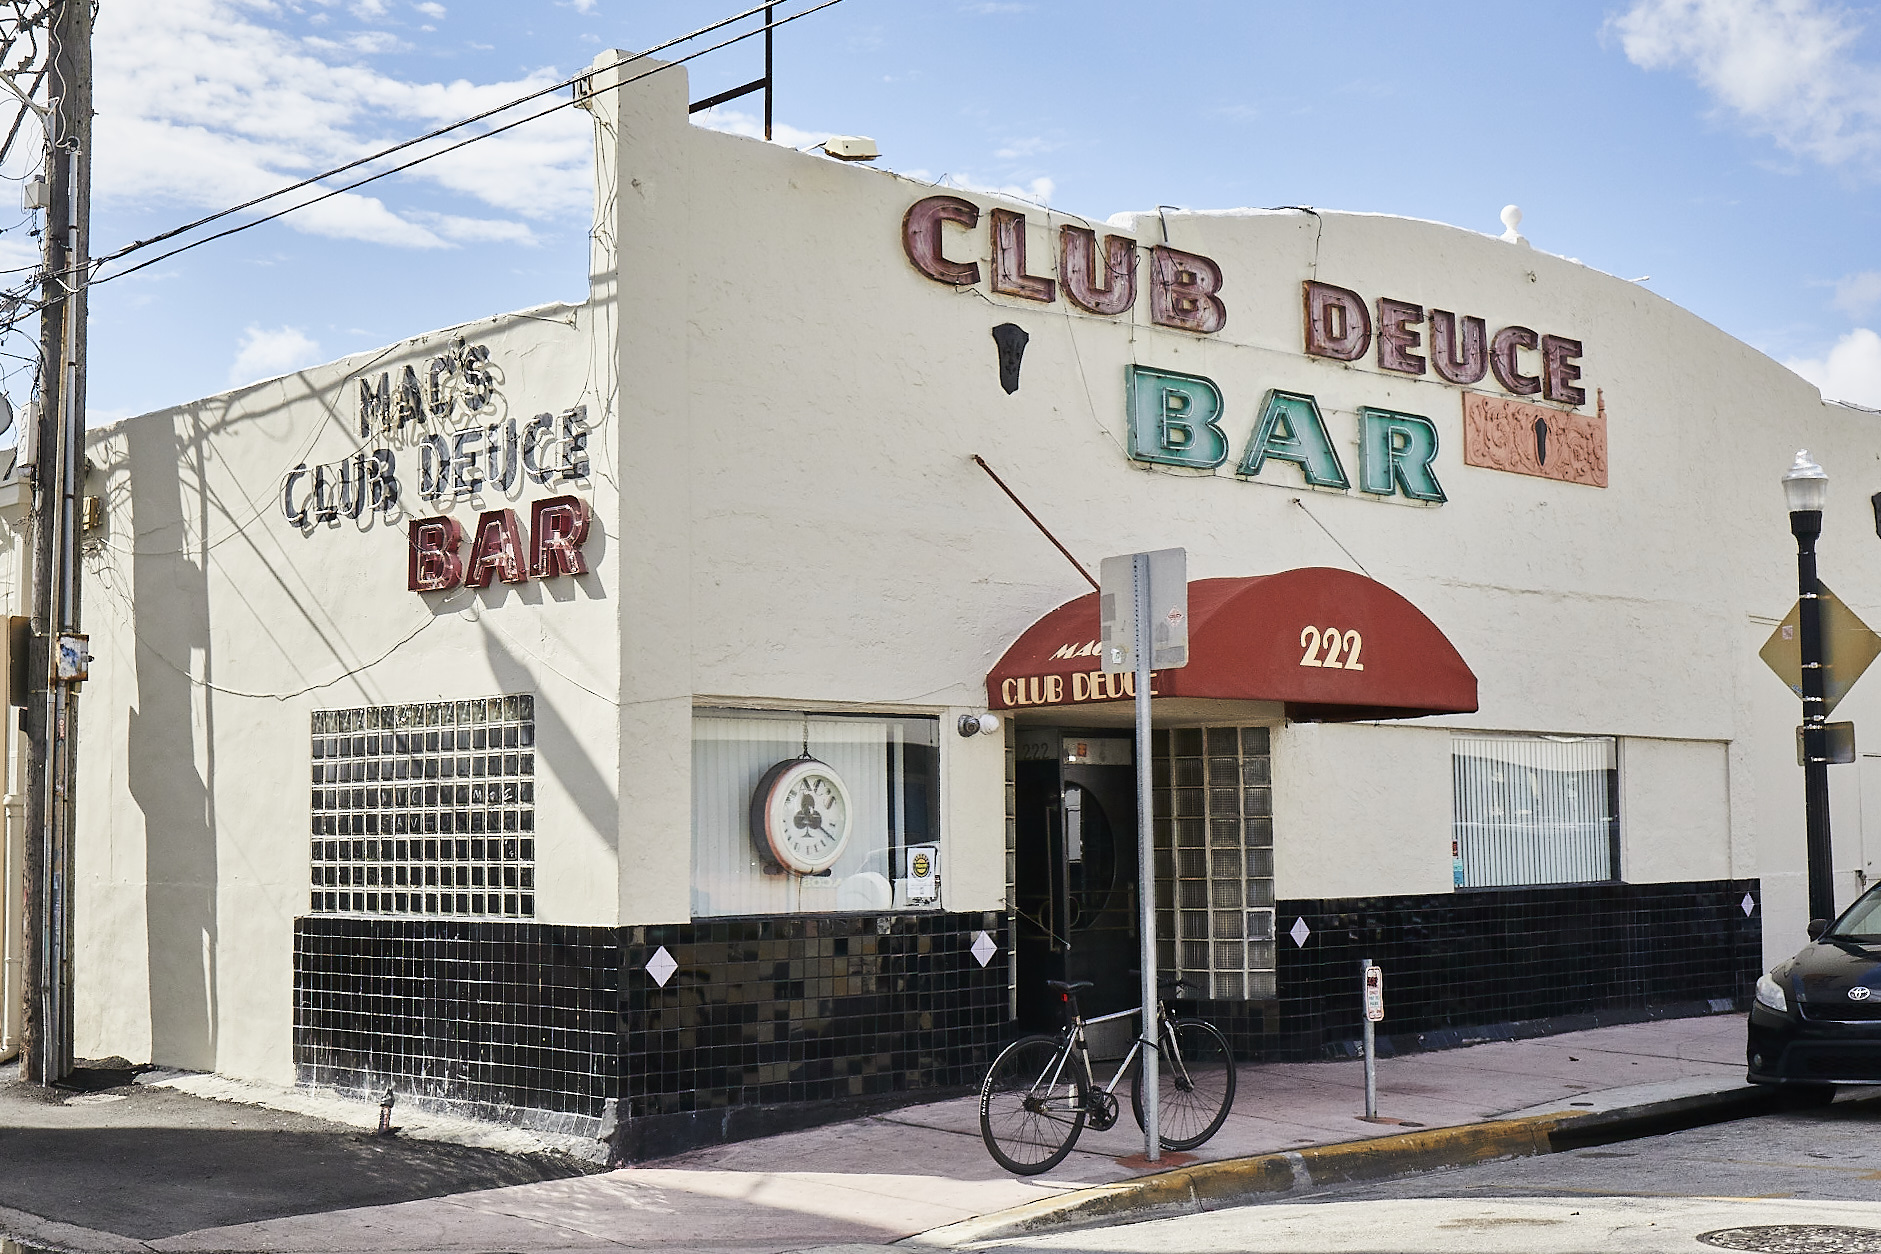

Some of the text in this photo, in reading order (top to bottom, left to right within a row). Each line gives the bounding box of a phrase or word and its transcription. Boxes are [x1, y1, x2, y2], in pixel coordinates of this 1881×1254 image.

[902, 195, 1586, 405] CLUB DEUCE
[281, 405, 591, 528] CLUB DEUCE
[1126, 363, 1448, 503] BAR
[408, 495, 592, 592] BAR
[1002, 675, 1063, 706] CLUB
[1300, 625, 1364, 671] 222
[1023, 743, 1050, 760] 222
